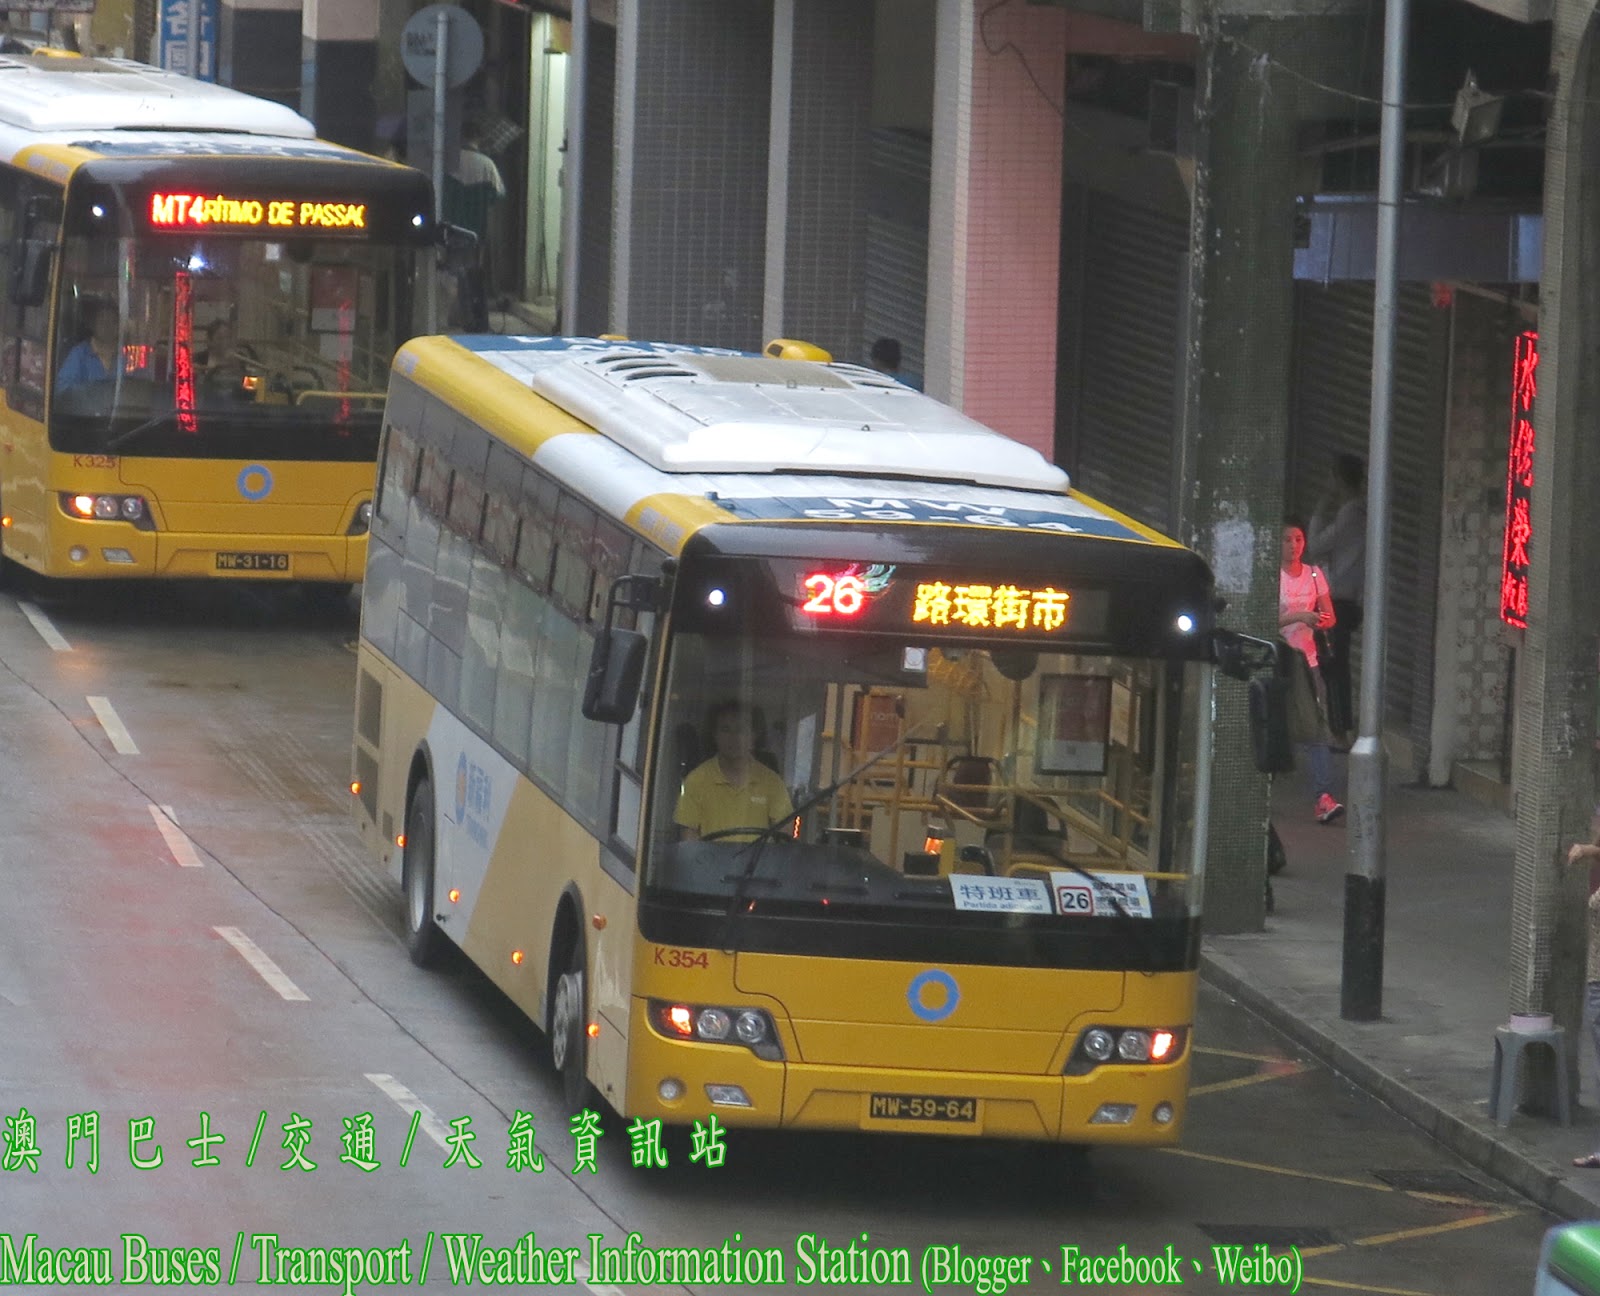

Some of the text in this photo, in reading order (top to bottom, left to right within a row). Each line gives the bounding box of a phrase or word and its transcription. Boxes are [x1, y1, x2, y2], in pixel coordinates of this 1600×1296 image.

[151, 194, 204, 224] MT4
[267, 201, 295, 226] DE
[826, 497, 1006, 517] MW
[803, 508, 1083, 533] 59-64
[217, 553, 287, 569] MW-31-16
[803, 573, 864, 615] 26
[912, 580, 1070, 632] 路環街市
[1062, 891, 1090, 910] 26
[654, 946, 709, 969] K354
[872, 1096, 974, 1119] MW-59-64
